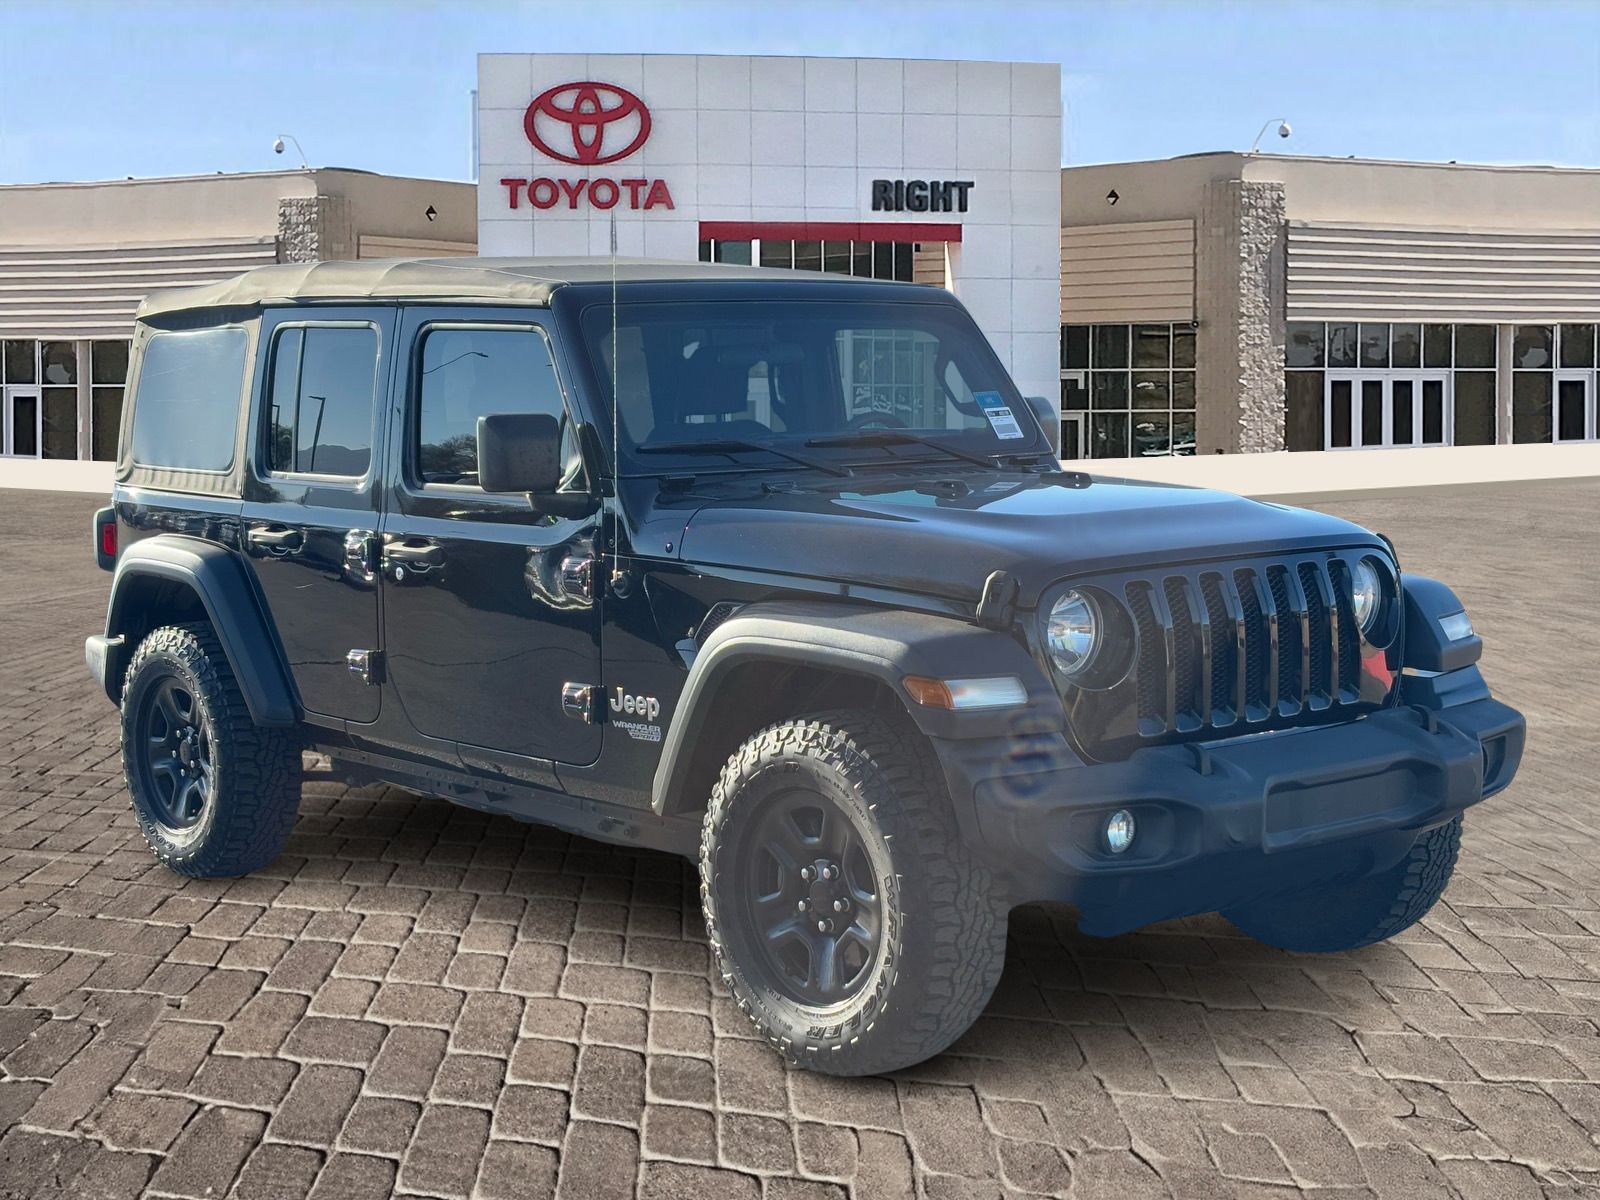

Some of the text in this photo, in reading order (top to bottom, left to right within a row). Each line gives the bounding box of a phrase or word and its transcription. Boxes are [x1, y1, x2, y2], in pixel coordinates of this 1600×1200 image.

[500, 178, 675, 209] TOYOTA
[872, 179, 975, 212] RIGHT
[610, 686, 660, 721] Jeep
[612, 719, 661, 732] WRANGLER
[806, 874, 897, 1040] WRANGLER
